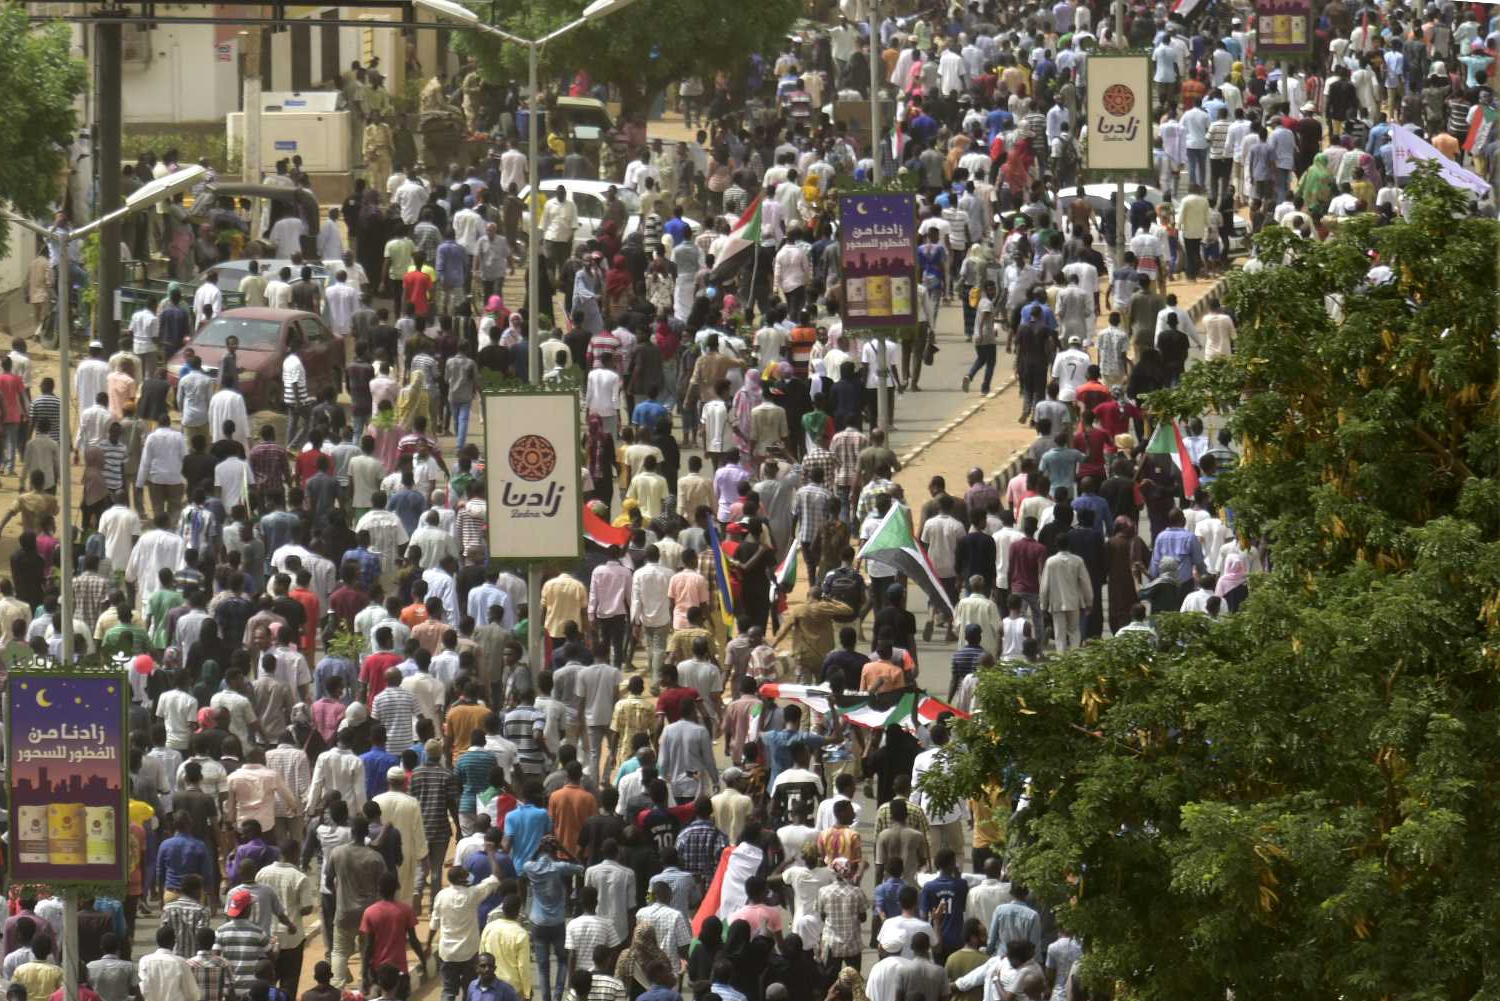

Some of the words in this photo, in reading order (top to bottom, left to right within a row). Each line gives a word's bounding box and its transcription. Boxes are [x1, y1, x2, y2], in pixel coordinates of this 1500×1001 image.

[1067, 362, 1077, 381] 7
[502, 481, 565, 518] زادنا
[28, 727, 59, 744] من
[61, 723, 105, 745] زادنا
[17, 746, 67, 762] للسحور
[68, 746, 116, 763] الفطور
